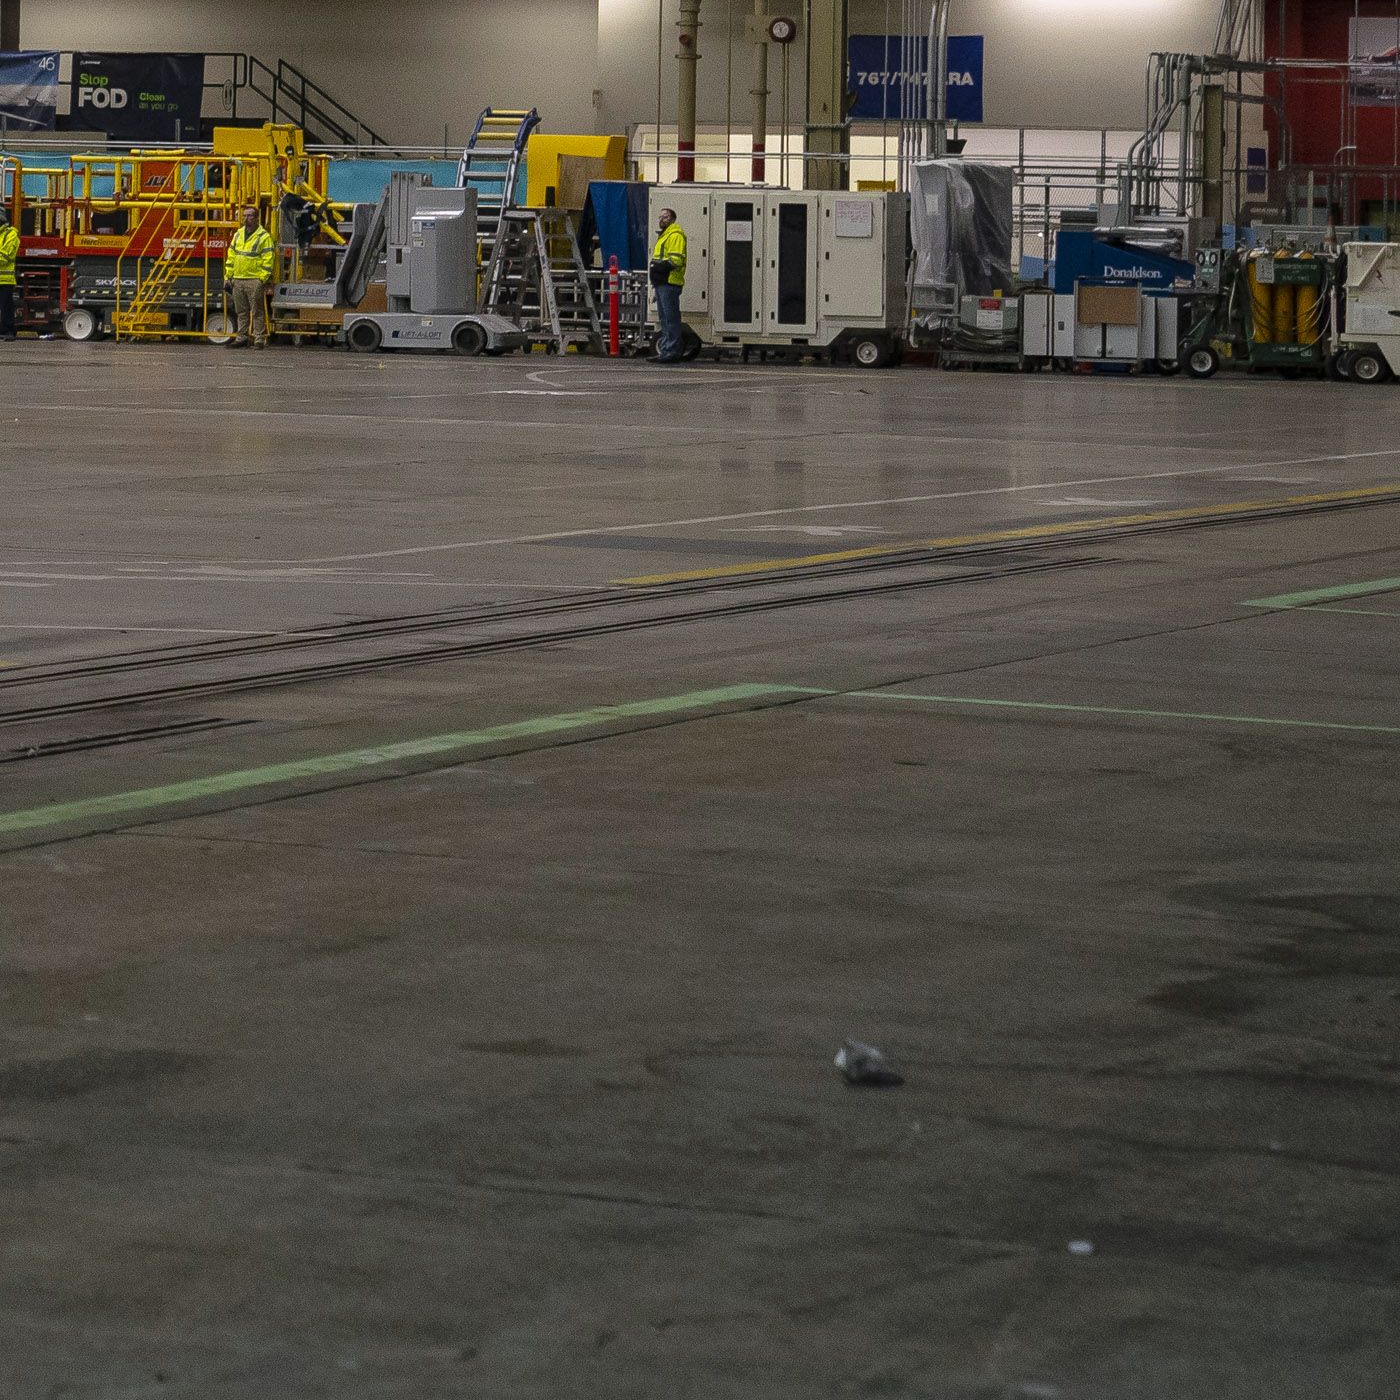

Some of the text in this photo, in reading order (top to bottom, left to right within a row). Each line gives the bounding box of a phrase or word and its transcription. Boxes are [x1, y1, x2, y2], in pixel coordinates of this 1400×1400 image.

[38, 57, 55, 71] 46
[79, 73, 109, 86] Stop
[78, 87, 128, 109] FOD
[139, 92, 166, 102] Clean
[151, 103, 165, 111] you
[167, 103, 178, 112] go
[96, 278, 136, 287] SKYJACK
